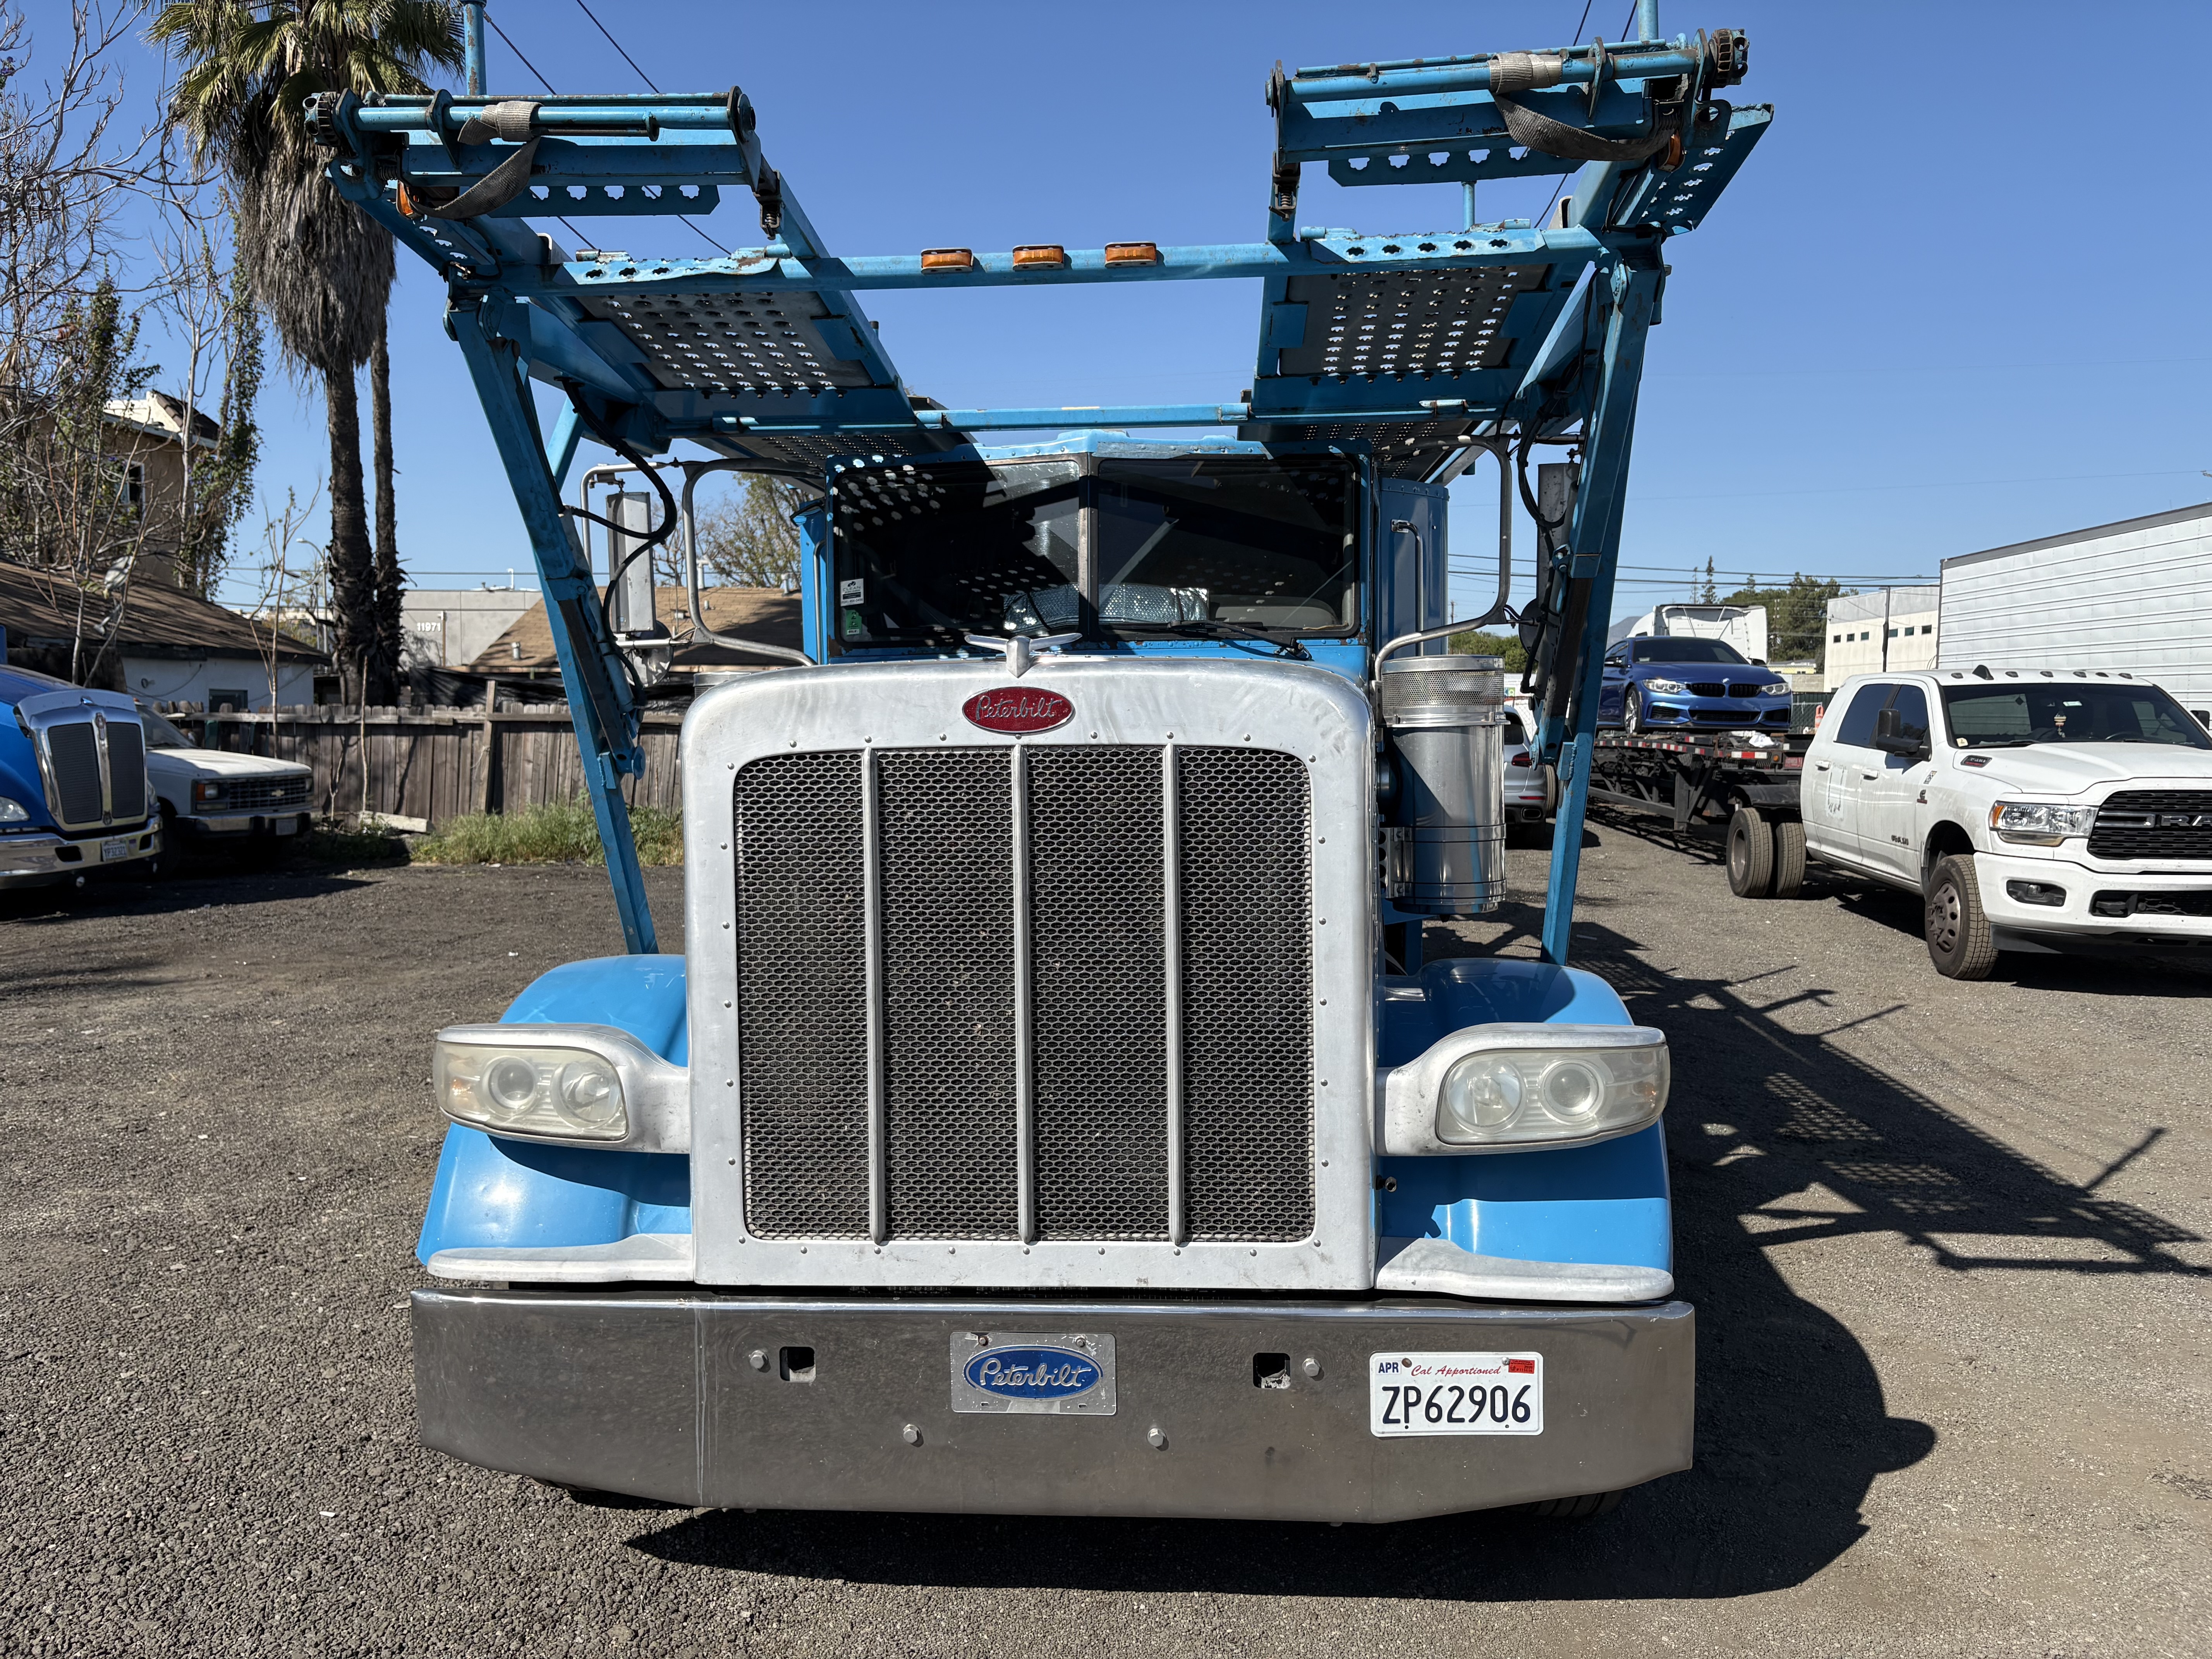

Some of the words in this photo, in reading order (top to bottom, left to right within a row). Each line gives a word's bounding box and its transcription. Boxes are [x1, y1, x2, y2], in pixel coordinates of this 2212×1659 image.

[417, 622, 441, 631] 11971
[975, 696, 1063, 721] Peterbilt
[979, 1357, 1091, 1387] Peterbilt
[1378, 1362, 1399, 1373] APR
[1411, 1365, 1432, 1376] Cal
[1435, 1365, 1501, 1377] Apportioned
[1382, 1385, 1531, 1424] ZP62906
